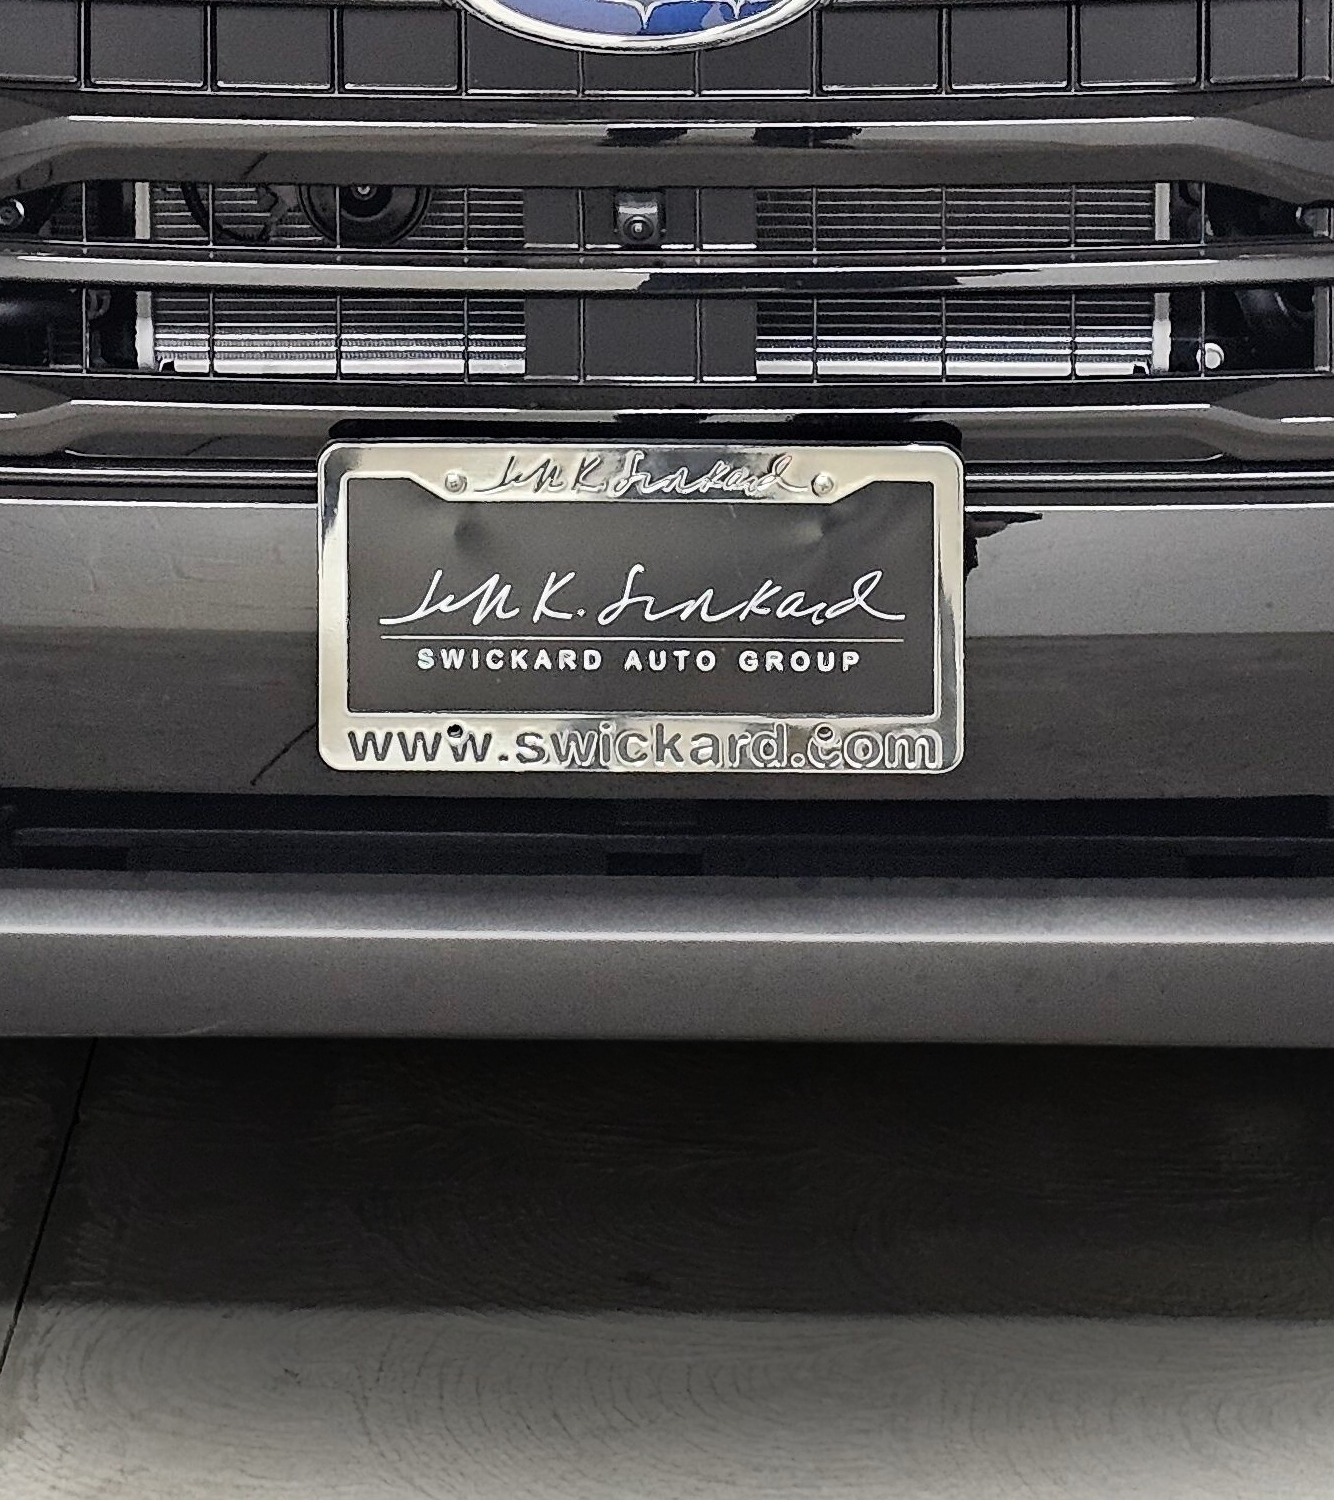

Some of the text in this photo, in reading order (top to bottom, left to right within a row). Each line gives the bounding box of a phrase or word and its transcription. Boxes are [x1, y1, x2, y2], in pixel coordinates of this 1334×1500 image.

[417, 648, 860, 672] SWICKARD AUTO GROUP
[347, 722, 944, 769] www.swickard.com
